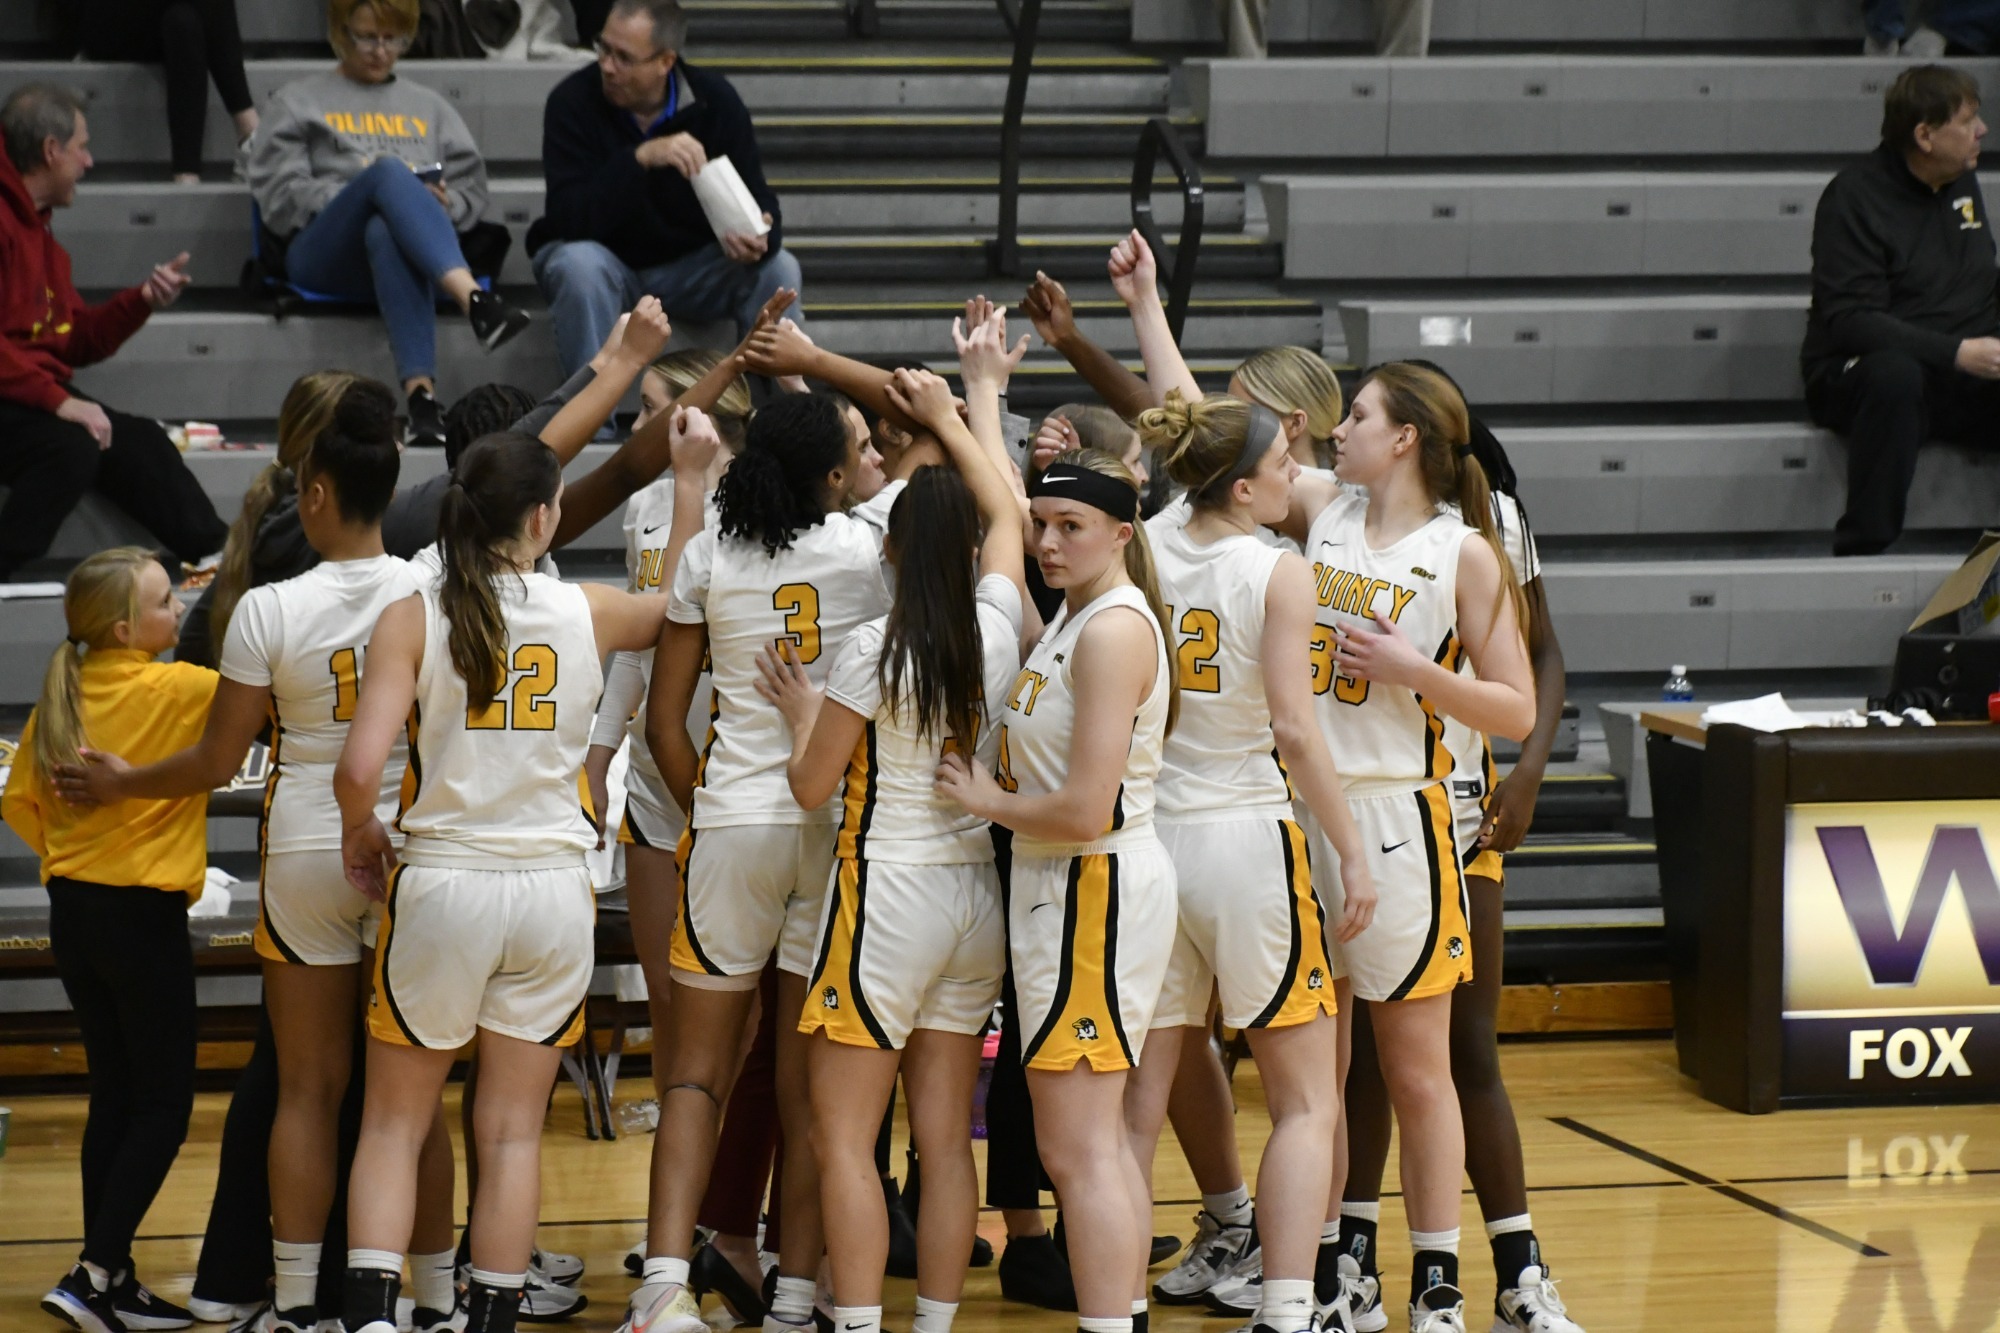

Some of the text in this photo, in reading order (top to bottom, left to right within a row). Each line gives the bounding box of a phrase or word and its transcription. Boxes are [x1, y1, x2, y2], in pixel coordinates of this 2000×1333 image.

[772, 582, 822, 665] 3
[1164, 604, 1220, 693] 2
[1814, 823, 2000, 989] W
[1849, 1026, 1973, 1080] FOX
